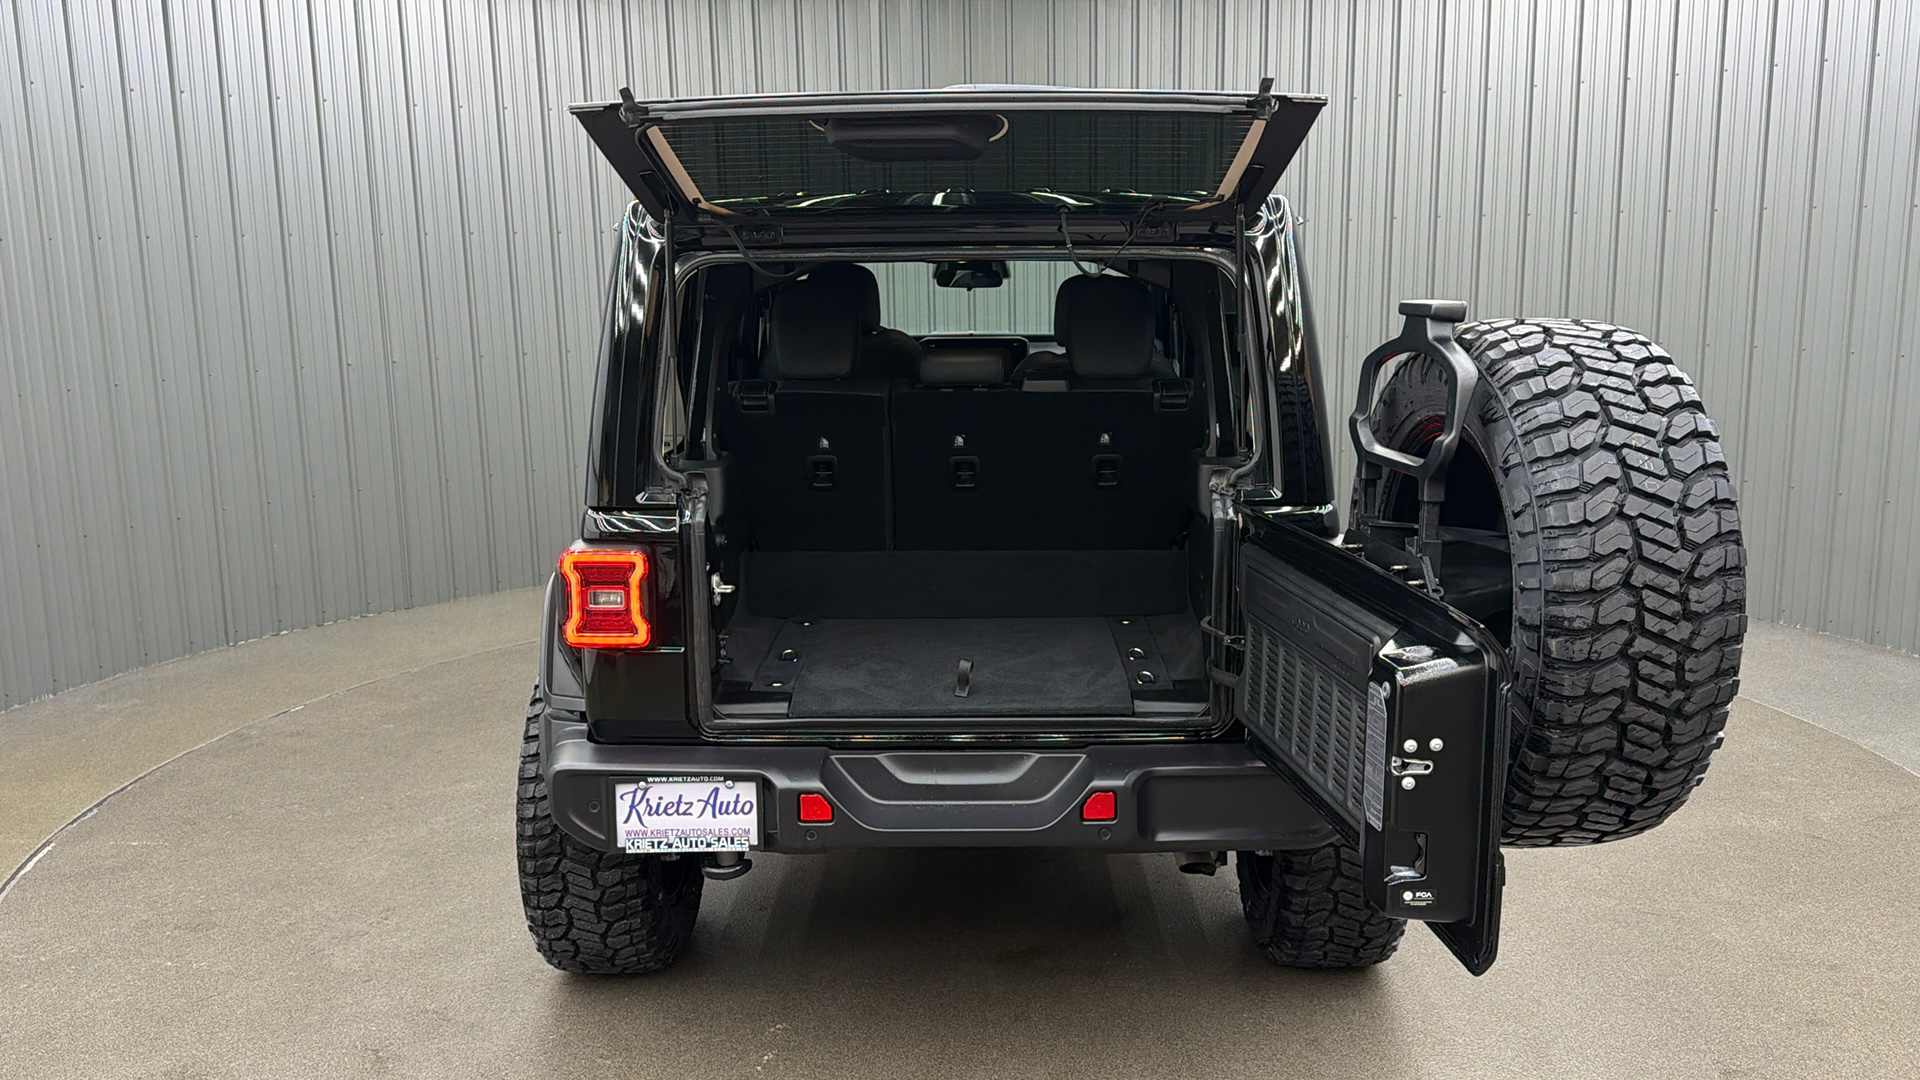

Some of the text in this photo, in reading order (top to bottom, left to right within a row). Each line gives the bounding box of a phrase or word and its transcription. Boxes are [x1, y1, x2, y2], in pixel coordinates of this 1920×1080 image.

[619, 786, 754, 828] Krietz Auto
[625, 828, 750, 837] WWW.KRIETZAUTOSALES.COM
[626, 837, 749, 849] KRIETZ AUTO SALES
